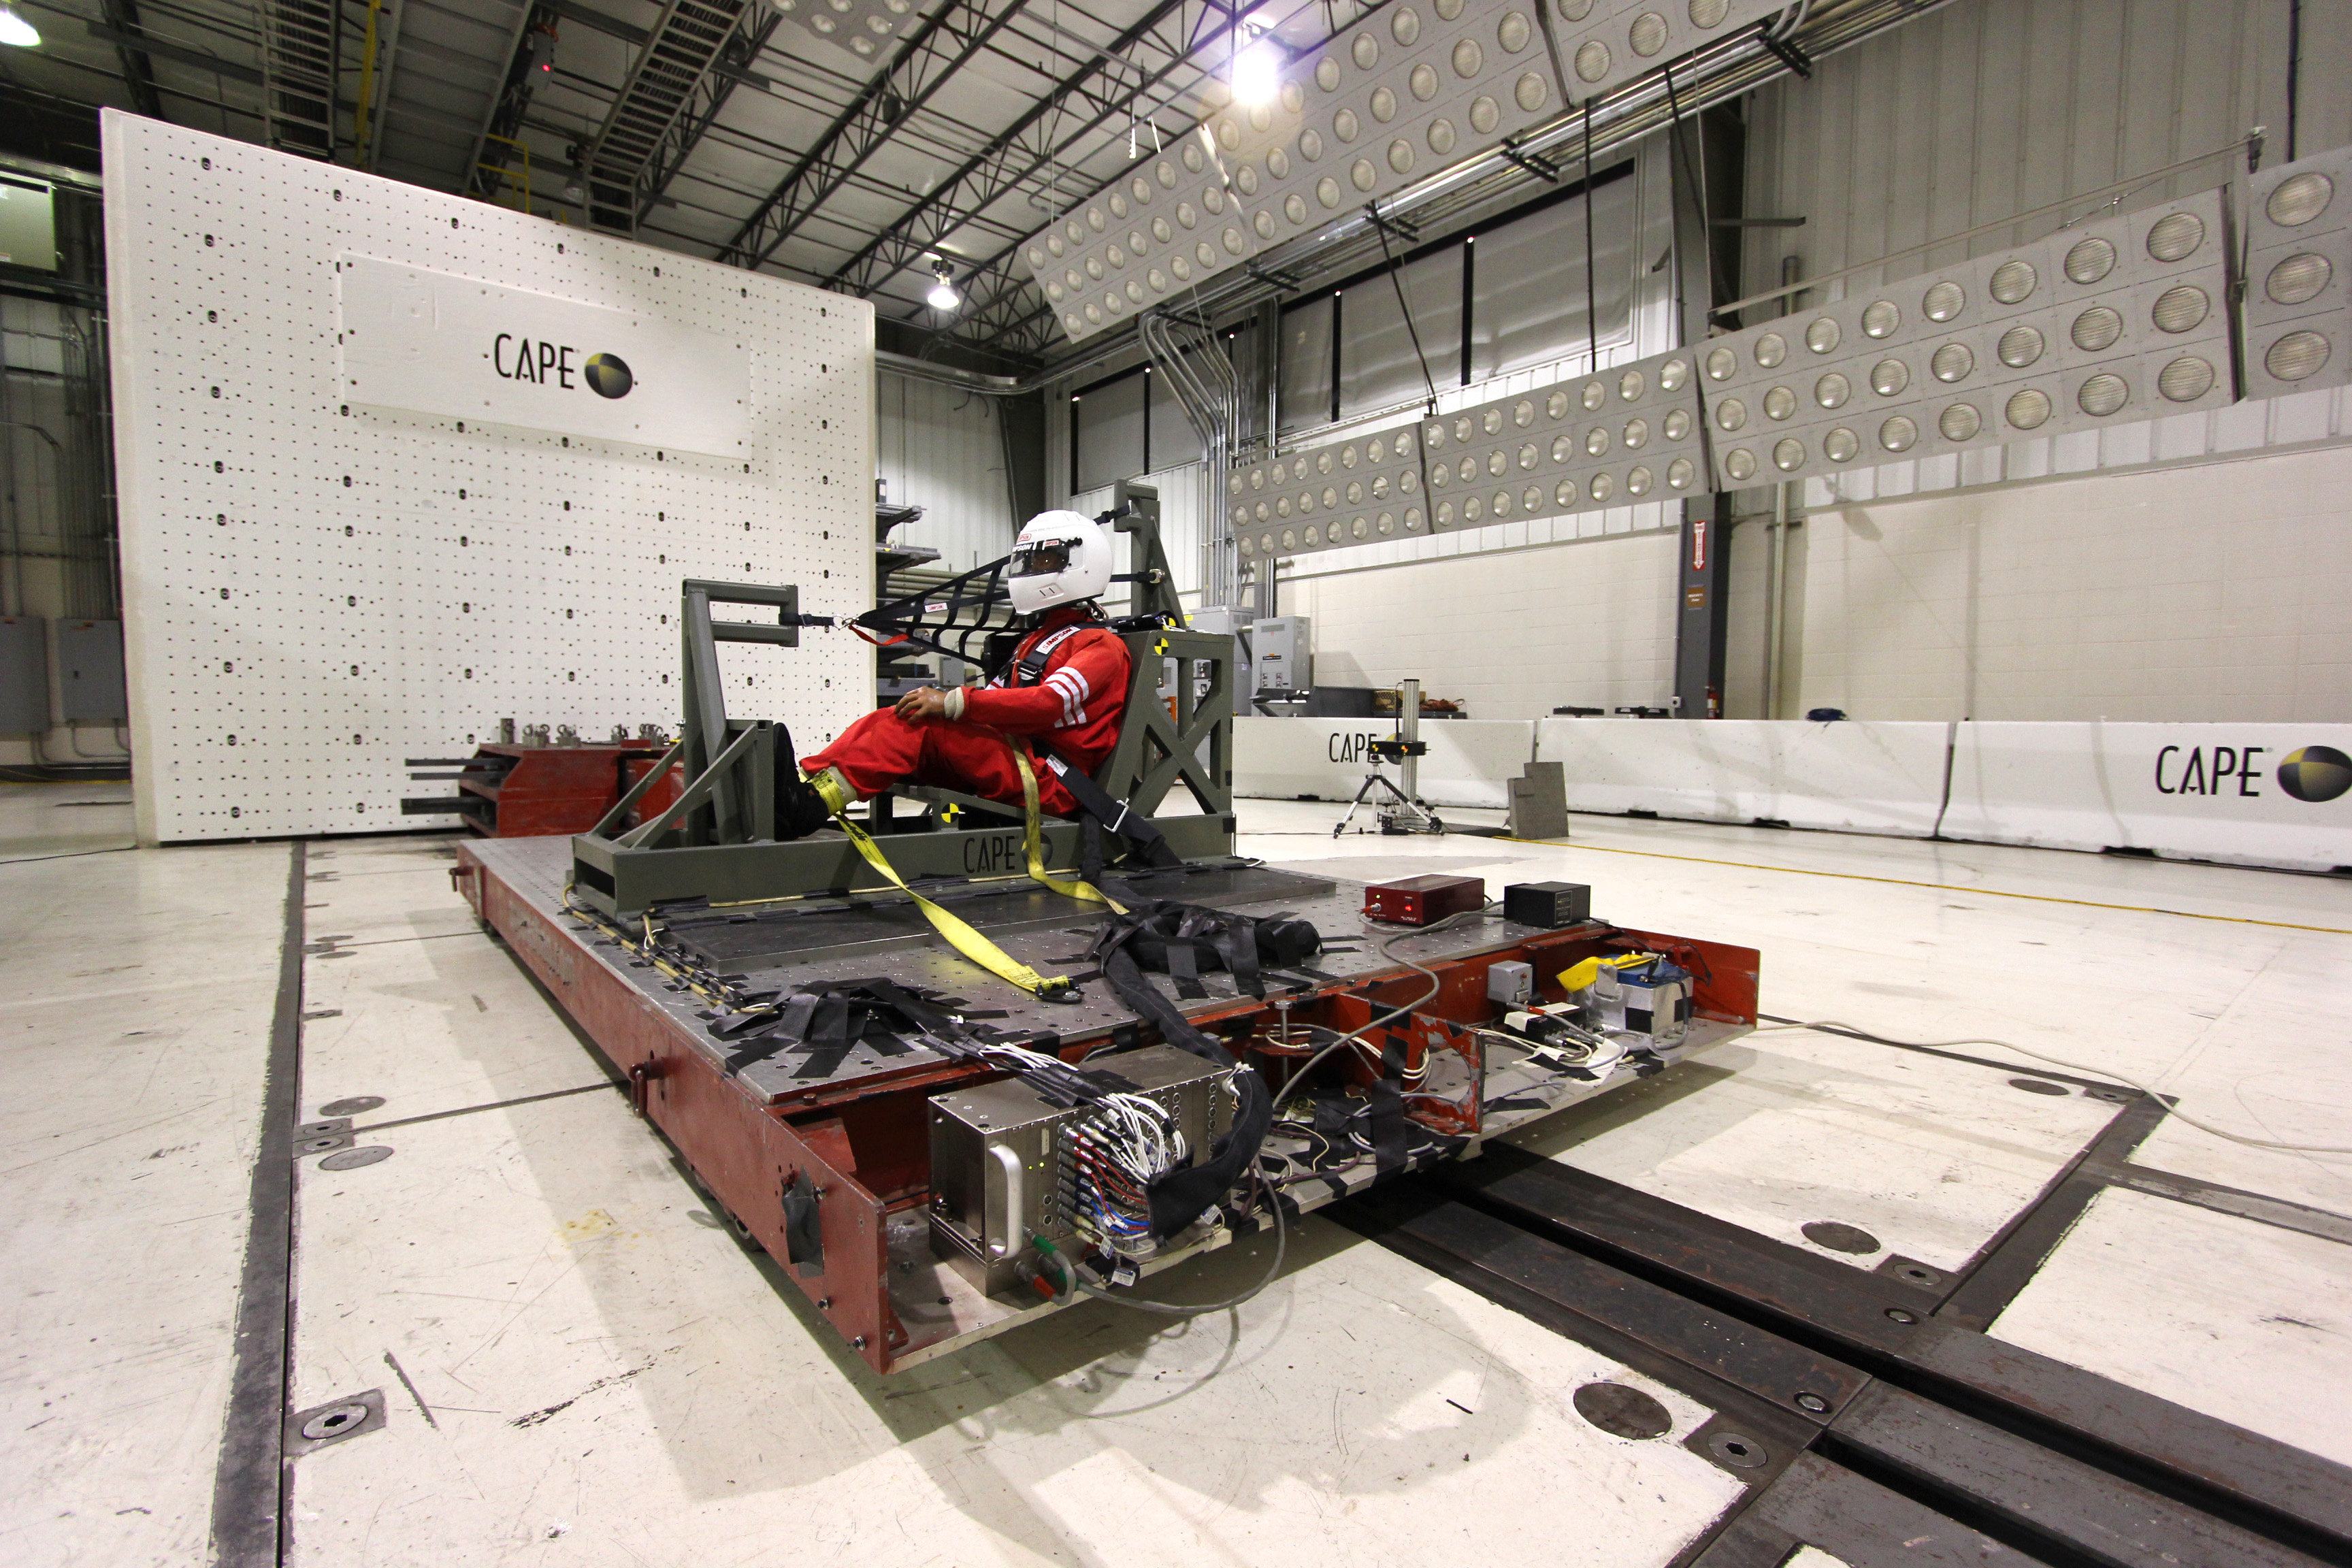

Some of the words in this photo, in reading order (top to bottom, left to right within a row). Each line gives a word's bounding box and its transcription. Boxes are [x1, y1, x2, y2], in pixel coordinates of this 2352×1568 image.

[494, 333, 574, 389] CAPE
[1043, 627, 1073, 650] SIMPSON
[2155, 745, 2264, 797] CAPE
[964, 835, 1015, 874] CAPE
